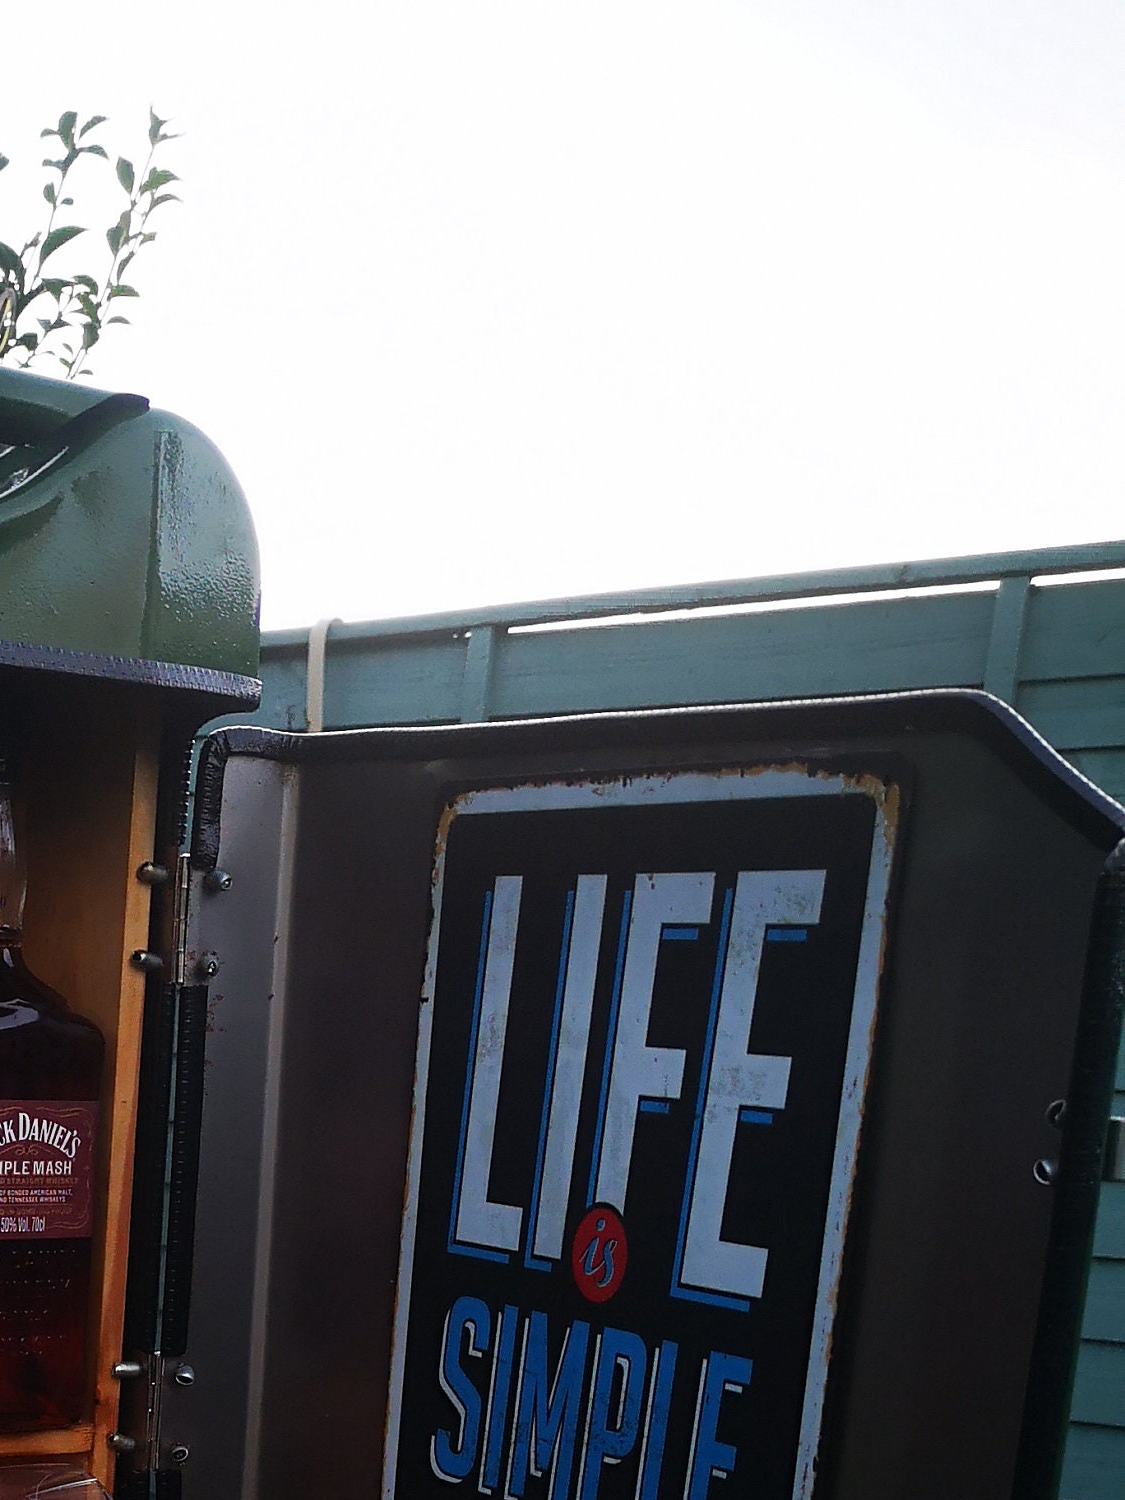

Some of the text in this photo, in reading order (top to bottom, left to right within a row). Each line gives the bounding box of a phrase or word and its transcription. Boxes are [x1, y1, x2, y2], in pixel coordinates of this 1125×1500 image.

[447, 869, 826, 1312] LIFE
[18, 1111, 83, 1160] DANIEL'S
[33, 1160, 73, 1175] MASH
[577, 1218, 619, 1288] is
